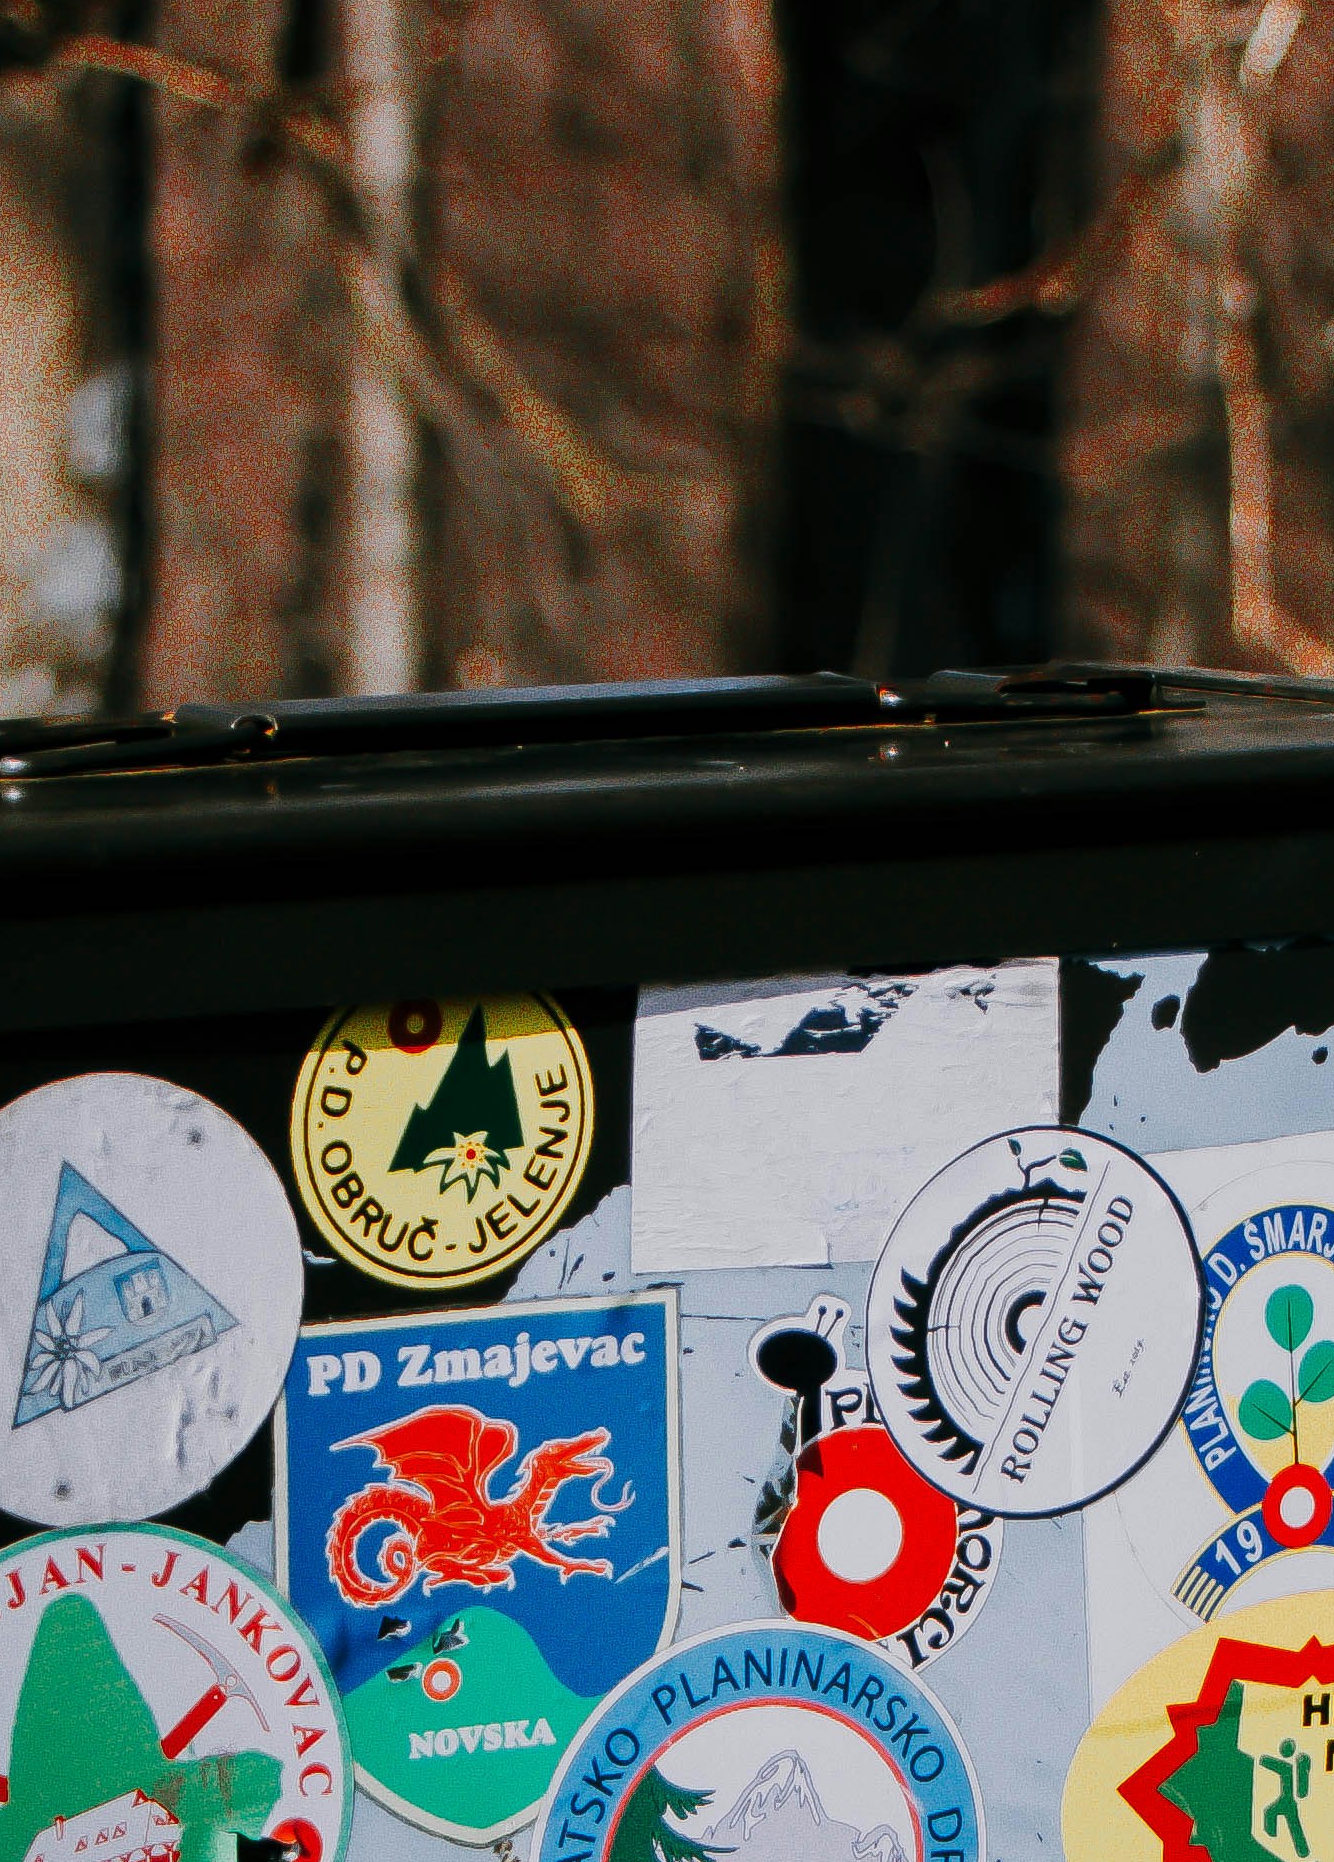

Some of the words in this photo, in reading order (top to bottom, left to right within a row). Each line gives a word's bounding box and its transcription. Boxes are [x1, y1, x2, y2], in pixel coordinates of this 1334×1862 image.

[307, 1350, 381, 1396] PD
[397, 1331, 647, 1388] Zmajevac
[1000, 1318, 1089, 1484] ROLLING
[1071, 1193, 1134, 1307] WOOD
[409, 1718, 557, 1760] NOVSKA
[651, 1647, 945, 1784] PLANINARSKO
